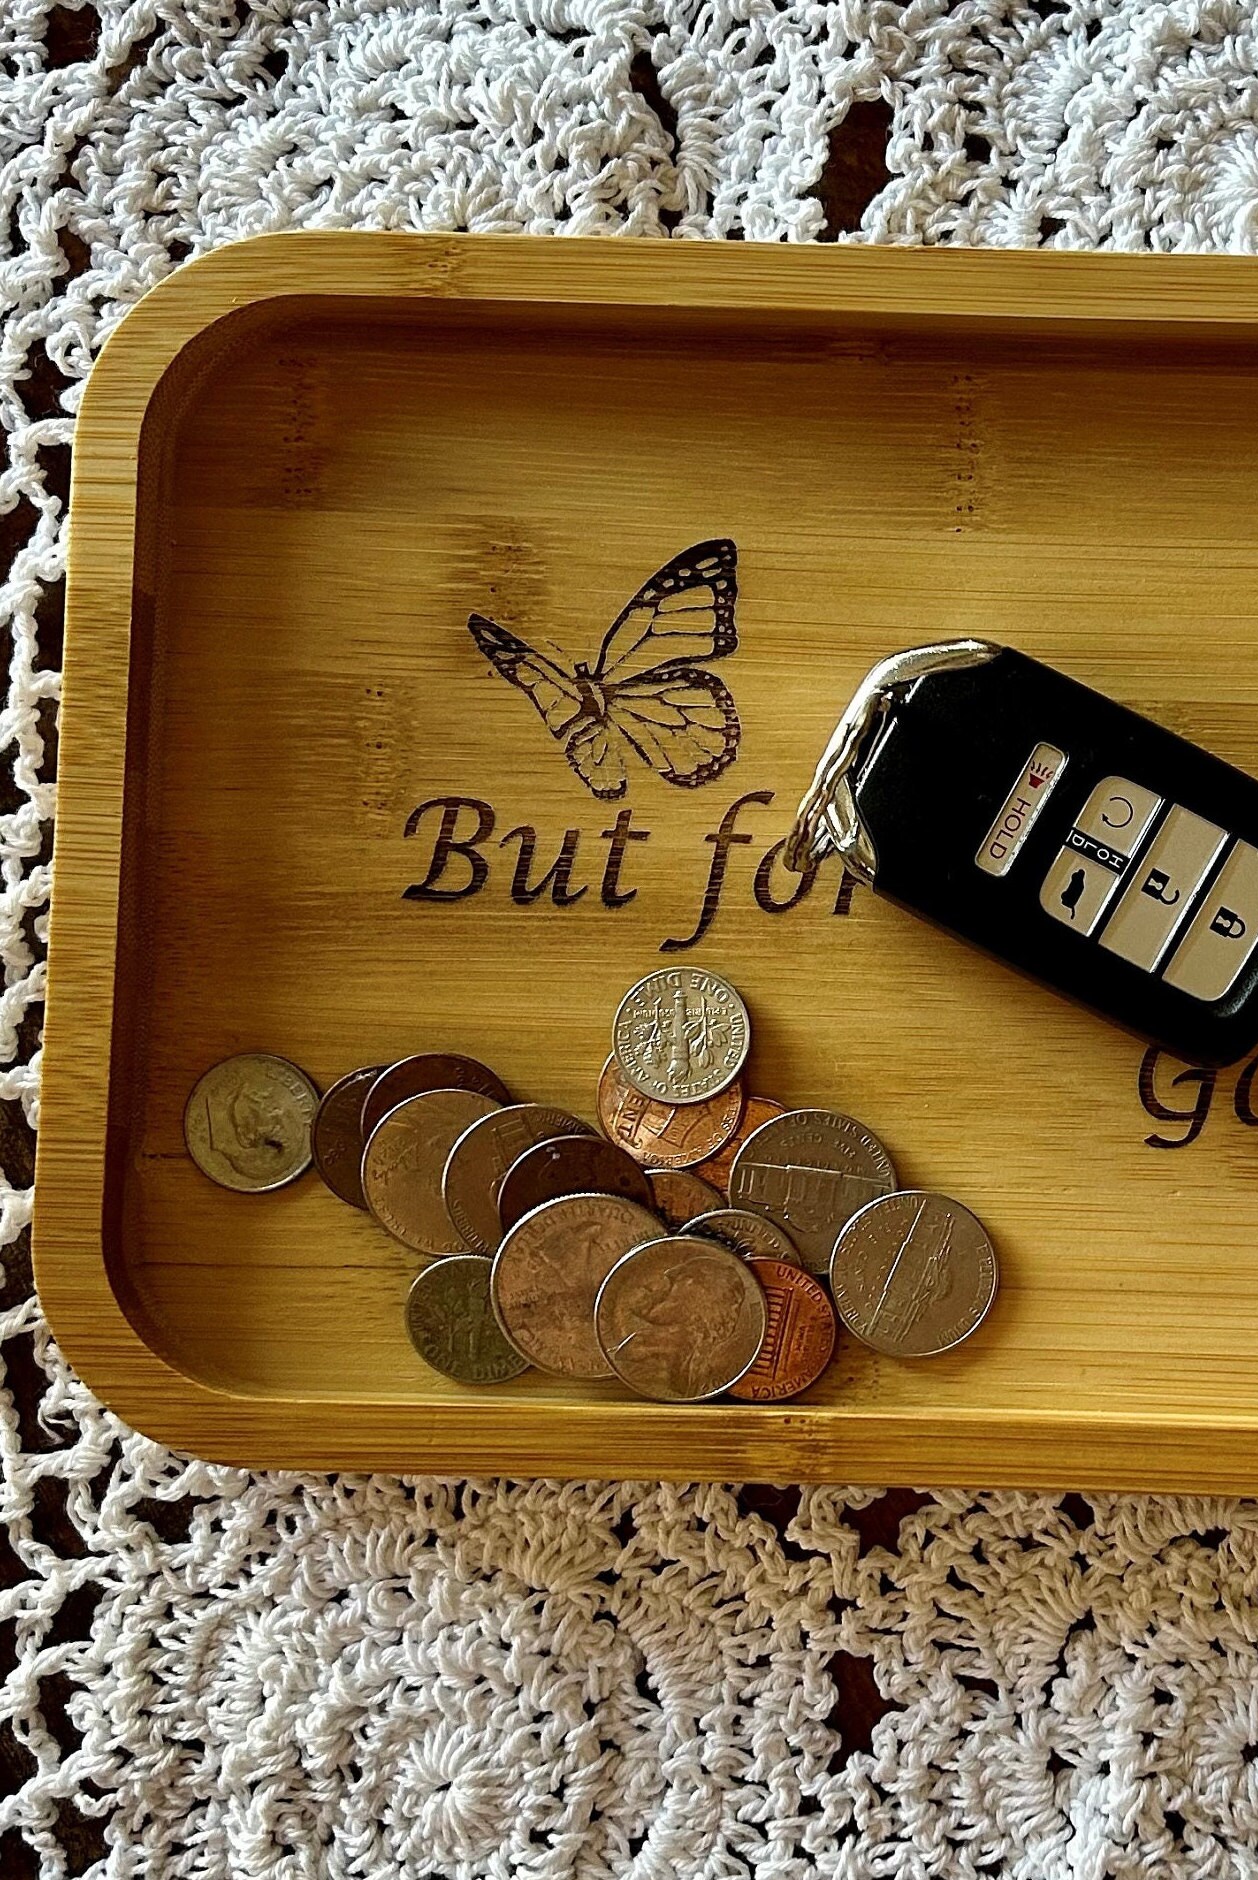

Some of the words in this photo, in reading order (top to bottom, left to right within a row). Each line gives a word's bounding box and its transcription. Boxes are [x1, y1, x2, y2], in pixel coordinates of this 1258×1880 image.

[989, 797, 1032, 860] HOLD
[400, 796, 652, 908] But
[690, 973, 729, 1006] ONE
[618, 1093, 645, 1139] ENT
[775, 1264, 823, 1302] UNITED
[750, 1368, 816, 1400] AMERICA
